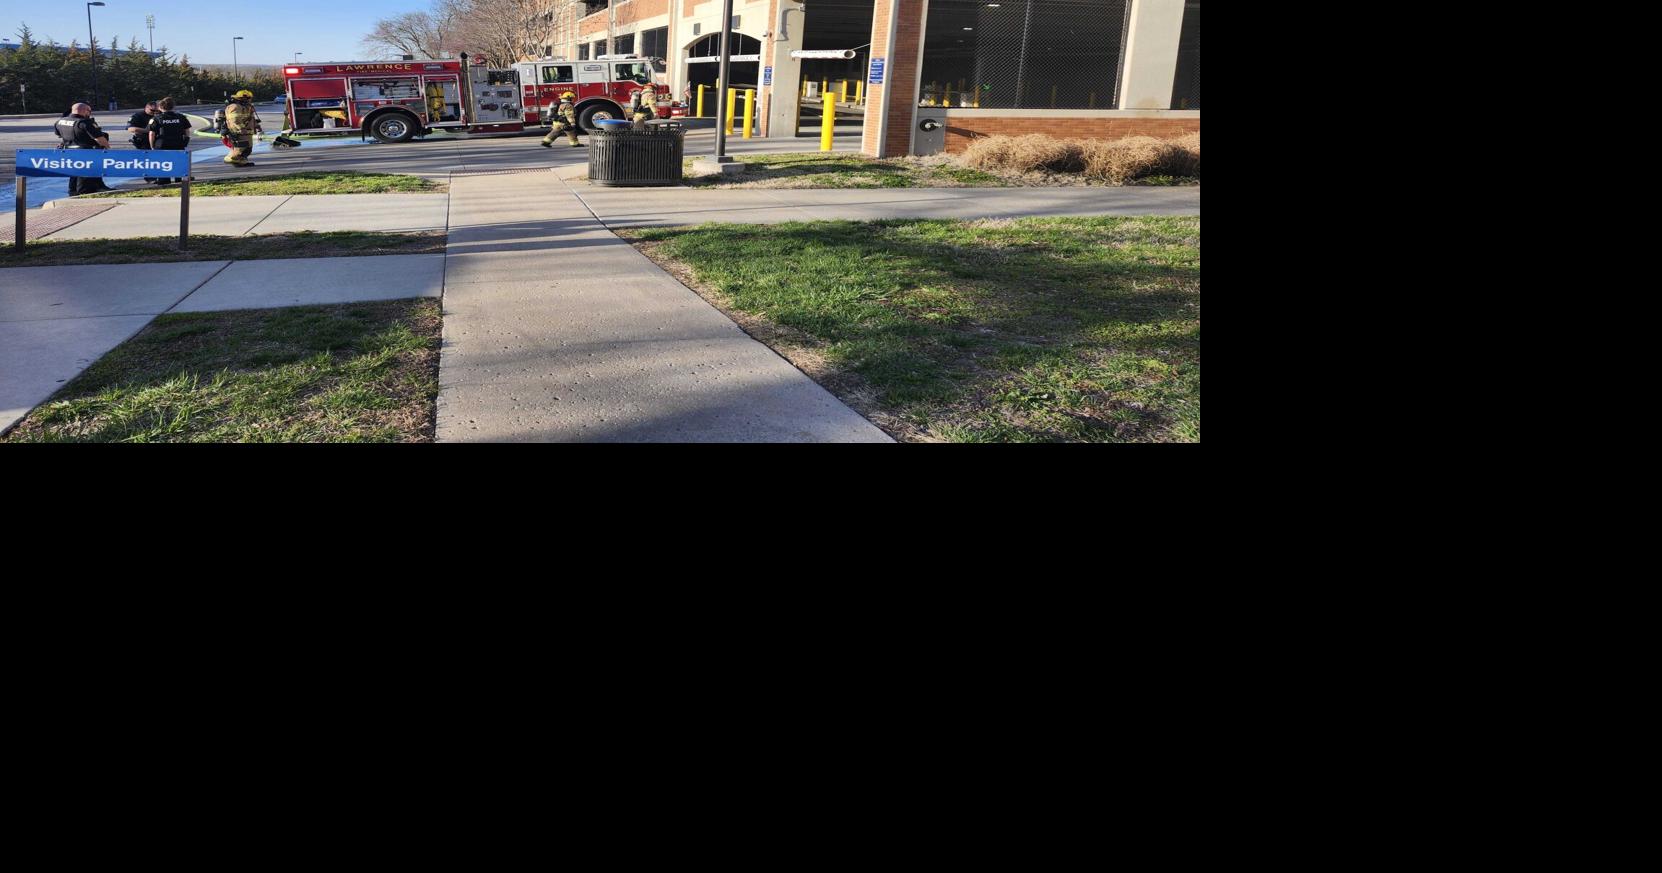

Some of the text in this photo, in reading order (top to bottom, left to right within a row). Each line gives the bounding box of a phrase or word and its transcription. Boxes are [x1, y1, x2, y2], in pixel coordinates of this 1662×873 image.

[336, 64, 411, 72] LAWRENCE
[58, 119, 75, 127] POLICE
[30, 157, 173, 171] Visitor Parking
